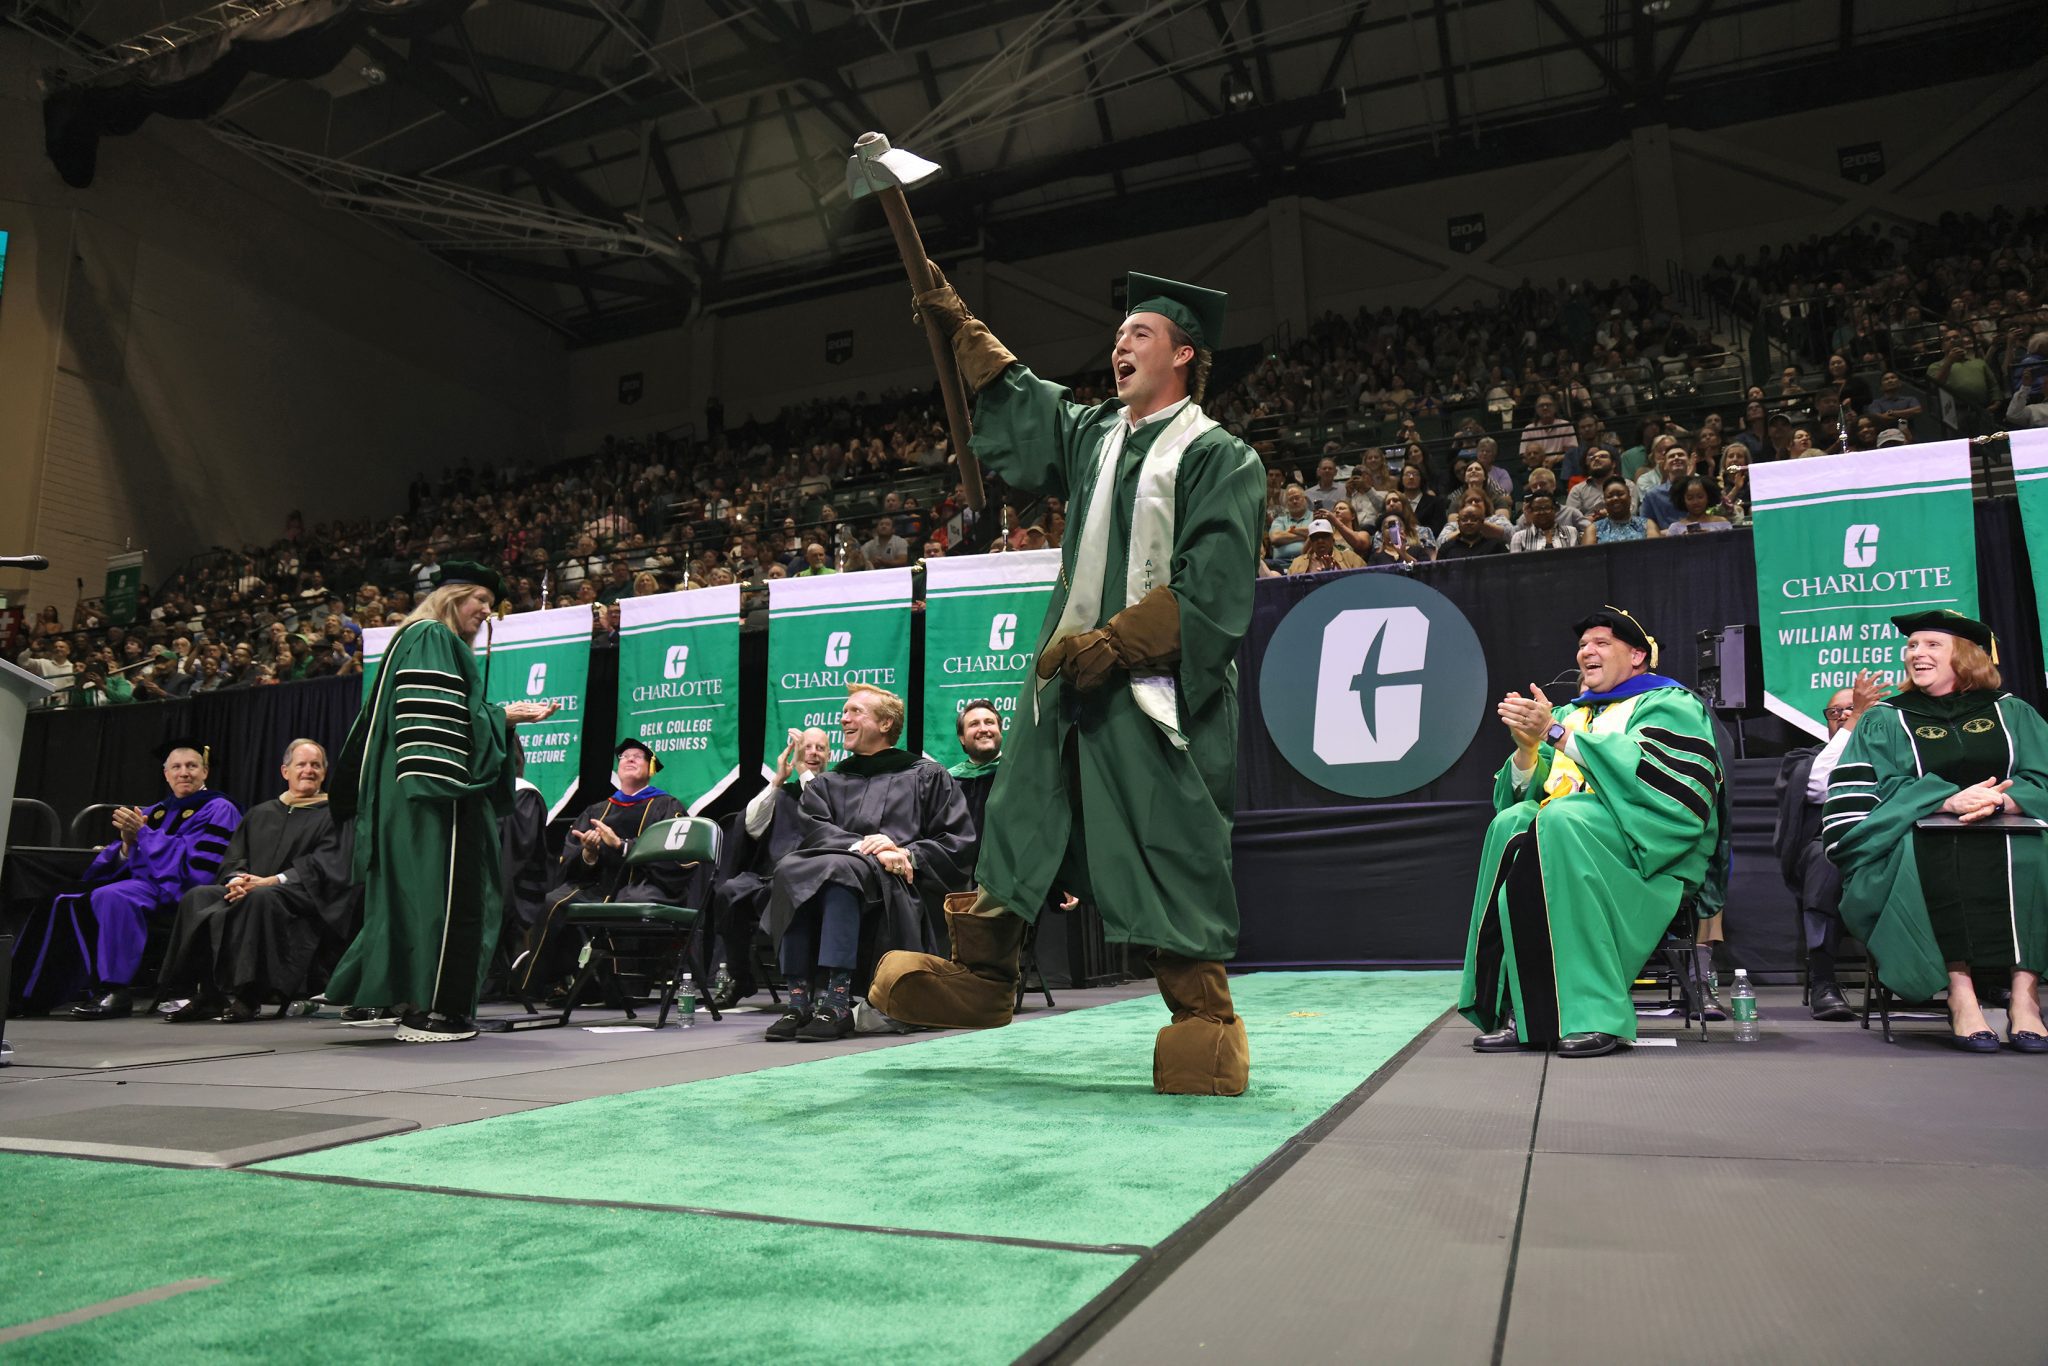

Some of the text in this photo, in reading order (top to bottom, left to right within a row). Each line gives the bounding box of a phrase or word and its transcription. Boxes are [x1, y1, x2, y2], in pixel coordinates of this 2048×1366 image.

[1842, 151, 1881, 168] 205
[1450, 222, 1484, 237] 204
[1782, 566, 1951, 598] CHARLOTTE
[1778, 623, 1901, 646] WILLIAM STAT
[943, 653, 1034, 674] CHARLOT
[1818, 646, 1893, 665] COLLEGE
[781, 668, 896, 690] CHARLOTTE
[632, 678, 723, 702] CHARLOTTE
[640, 719, 713, 737] BELK COLLEGE
[804, 711, 841, 727] COLLE
[532, 734, 546, 747] OF
[545, 732, 570, 746] ARTS
[655, 736, 708, 752] BUSINESS
